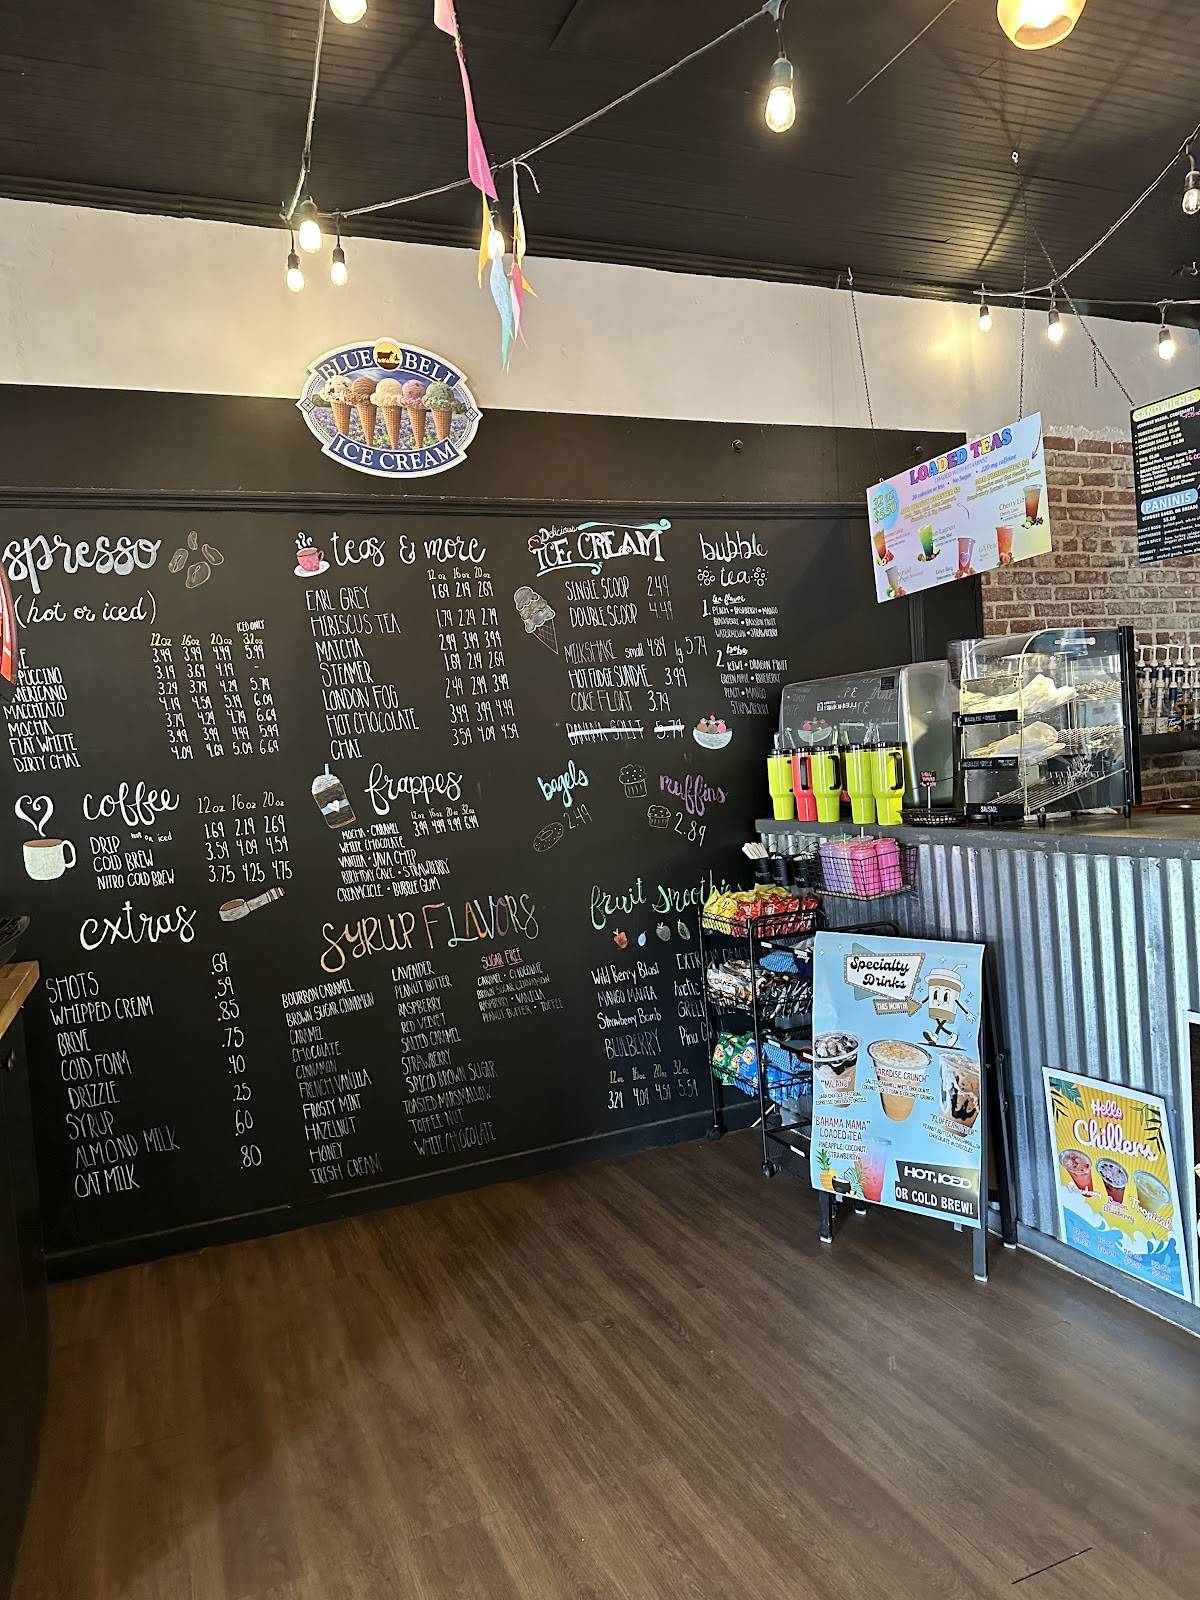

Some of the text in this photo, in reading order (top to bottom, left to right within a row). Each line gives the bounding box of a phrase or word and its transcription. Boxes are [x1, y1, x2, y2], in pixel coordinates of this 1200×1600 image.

[319, 350, 455, 383] BLUE BELL
[1135, 394, 1197, 419] SANDWICHES
[333, 436, 457, 470] ICE CREAM
[909, 448, 968, 485] LOADED
[970, 428, 1012, 458] TEAS
[1145, 492, 1191, 512] PANINIS
[539, 525, 577, 542] Delicious
[330, 531, 486, 566] teas & more
[533, 530, 665, 570] ICE CREAM
[699, 531, 768, 563] bubble
[565, 575, 669, 601] SINGLE SCOOP 2.49
[720, 567, 750, 586] tea
[14, 590, 156, 628] (hot or iced)
[306, 586, 370, 611] EARL GREY
[250, 620, 264, 630] ONLY
[310, 613, 401, 637] HIBISCUS TEA
[458, 609, 476, 626] 2.29
[569, 607, 607, 628] DOUBLE
[606, 603, 637, 626] SCOOP
[152, 645, 264, 662] 3.49 3.99 4.49 5.99
[315, 637, 364, 661] MATCHA
[564, 640, 644, 664] MILKSHAKE small
[319, 661, 374, 687] STEAMER
[568, 665, 688, 689] HOT FUDGE SUNDAE 3.99
[322, 684, 399, 711] LONDON FOG
[570, 690, 671, 712] COKE FLOAT 3.79
[3, 702, 65, 720] MACCHIATO
[326, 708, 419, 737] HOT CHOCOLATE
[8, 720, 54, 737] MOCHA
[9, 733, 77, 755] FLAT WHITE
[330, 739, 363, 760] CHAI
[13, 753, 81, 772] DIRTY CHAI
[364, 763, 463, 815] frappes
[537, 760, 588, 807] bagels
[660, 774, 727, 817] muffins
[83, 781, 180, 826] coffee
[564, 804, 593, 829] 2.49
[342, 823, 400, 840] MOCHA CARAMEL
[674, 812, 707, 847] 2.89
[90, 836, 120, 855] DRIP
[93, 841, 229, 873] COLD BREW 3.59
[339, 836, 406, 853] WHITE CHOCOLATE
[338, 848, 416, 868] VANILLA JAVA CHIP
[341, 858, 450, 884] BIRTHDAY CAKE STRAWBERRY
[97, 864, 235, 890] NITRO COLD BREW 3.75
[337, 876, 441, 902] CREAMCICLE BUBBLE GUM
[591, 877, 647, 930] fruit
[80, 900, 196, 950] extras
[320, 893, 539, 973] SYRUP FLAVORS
[391, 961, 435, 981] LAVENDER
[481, 948, 523, 970] SUGAR FREE
[850, 956, 909, 977] Specialty
[46, 952, 229, 1003] SHOTS .69
[591, 967, 610, 985] Wild
[612, 965, 637, 985] Berry
[638, 962, 660, 978] Blast
[862, 973, 906, 989] Drinks
[50, 976, 235, 1025] WHIPPED CREAM .59
[282, 979, 355, 1009] BOURBON CARAMEL
[285, 993, 375, 1027] BROWN SUGAR CINNAMON
[597, 1008, 662, 1030] Strawberry Bomb
[57, 999, 240, 1057] BREVE .85
[604, 1029, 662, 1060] BLUEBERRY
[61, 1050, 132, 1081] COLD FOAM
[68, 1055, 245, 1110] DRIZZLE .40
[303, 1094, 361, 1119] FROSTY MINT
[1091, 1099, 1123, 1120] Hello
[66, 1111, 114, 1140] SYRUP
[820, 1129, 847, 1139] LOADED
[75, 1125, 180, 1170] ALMOND MILK
[1073, 1119, 1158, 1162] Chillers
[74, 1164, 140, 1198] OAT MILK
[896, 1186, 973, 1215] OR COLD BREW!
[1129, 1195, 1173, 1231] Tropical
